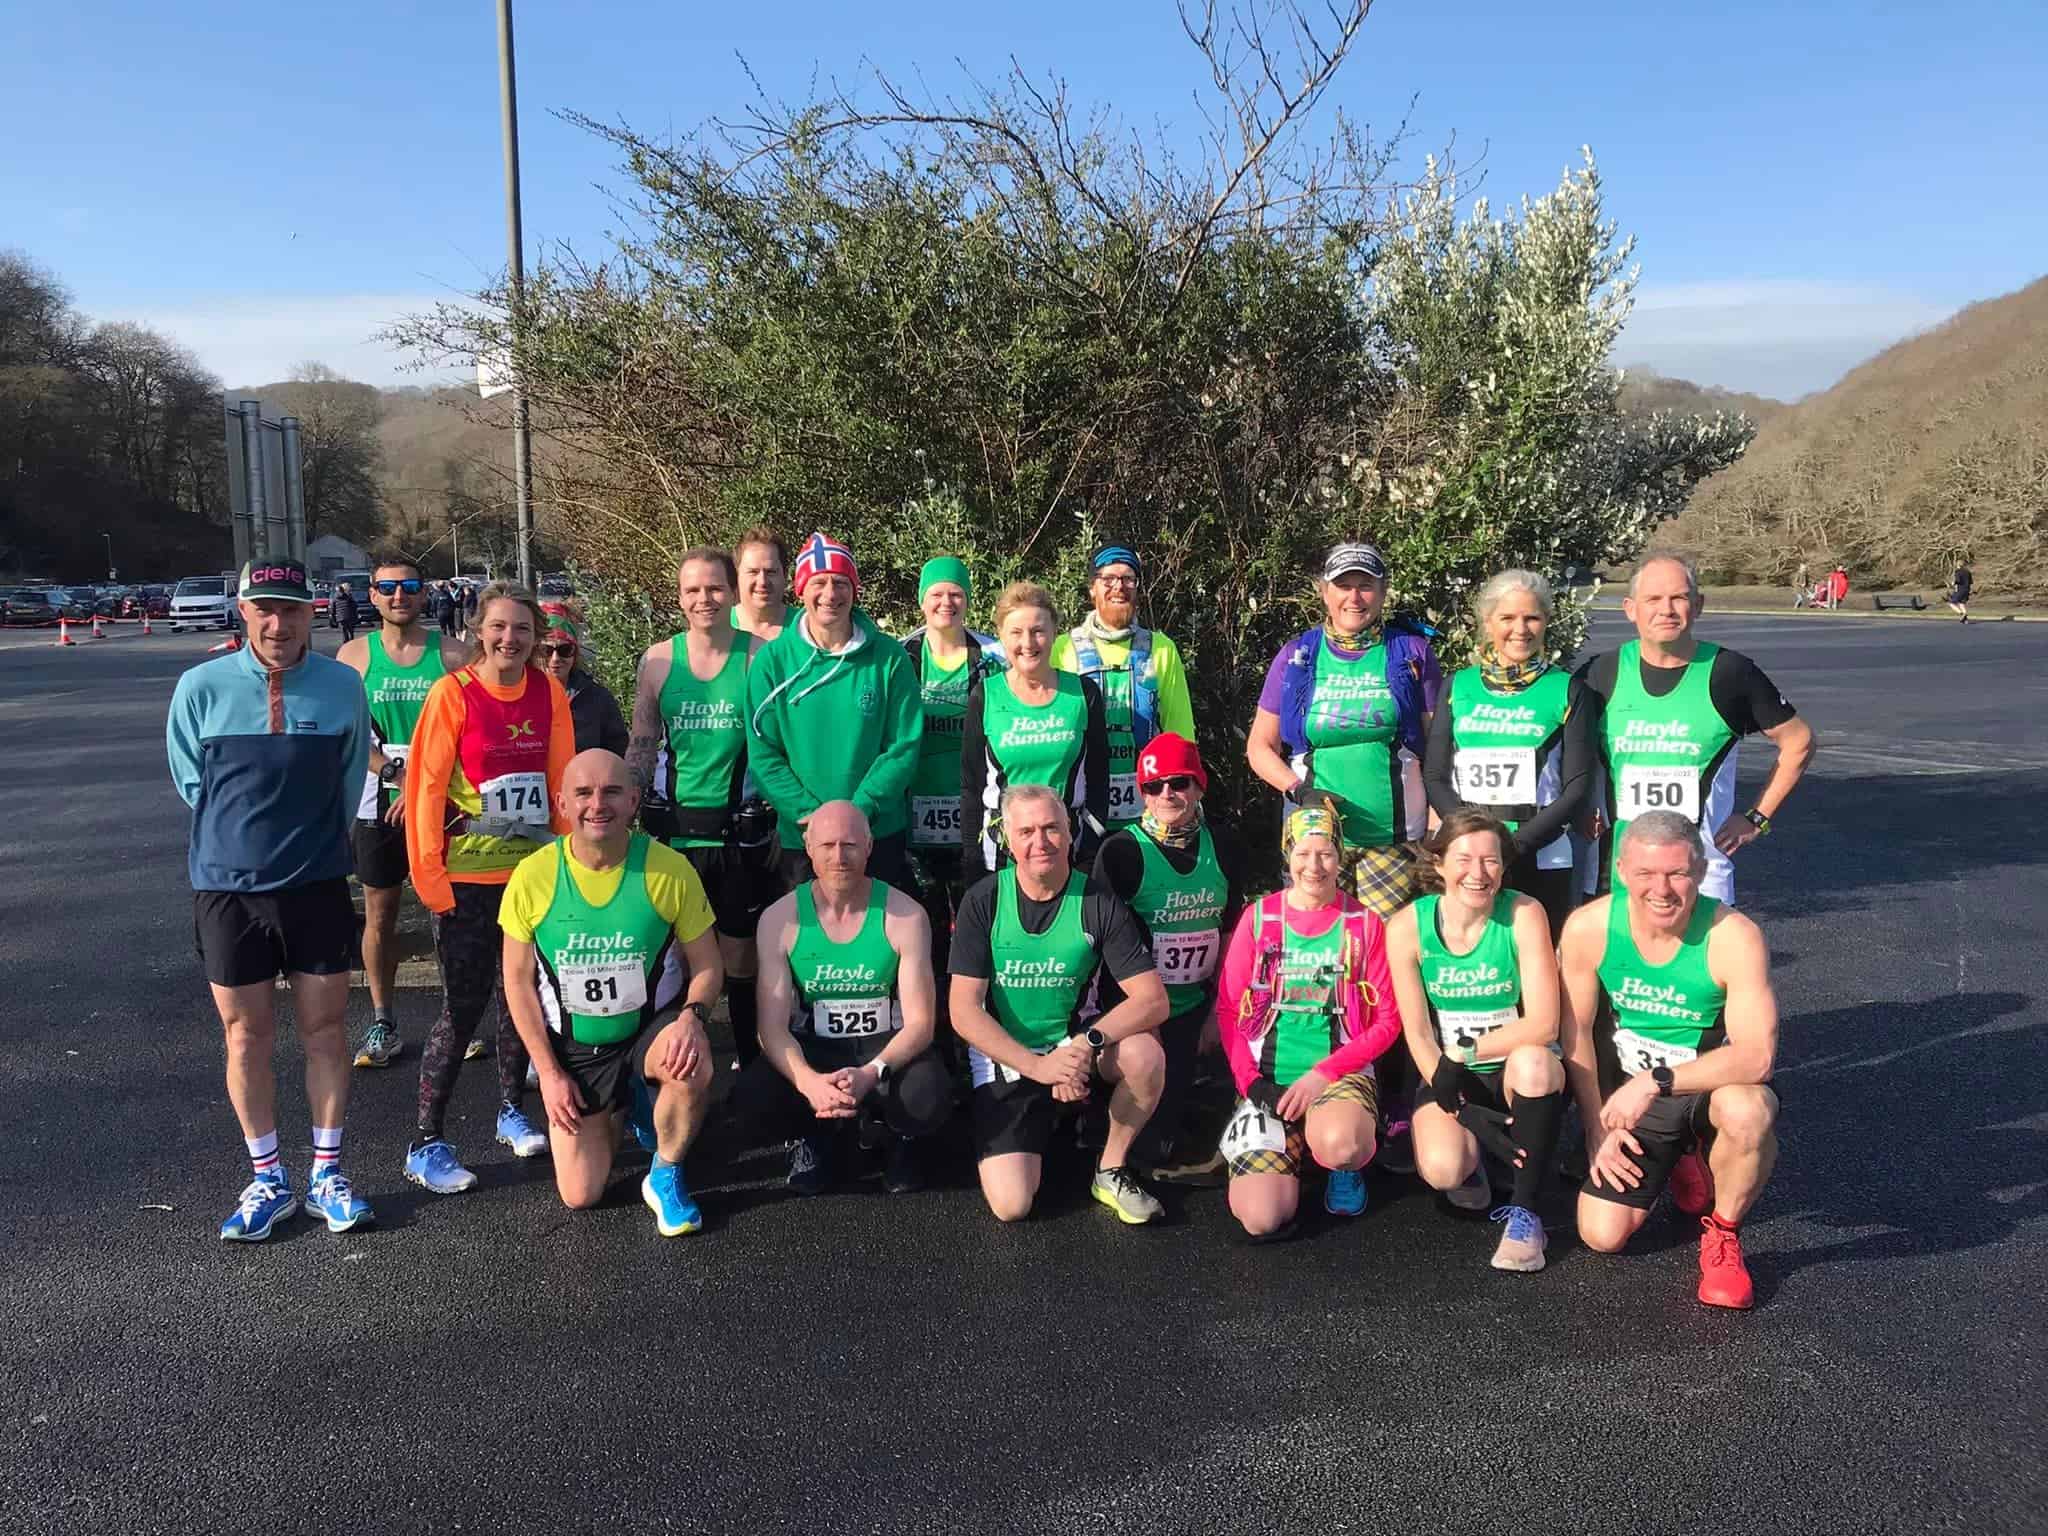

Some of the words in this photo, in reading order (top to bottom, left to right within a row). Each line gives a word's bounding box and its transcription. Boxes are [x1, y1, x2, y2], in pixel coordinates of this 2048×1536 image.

[251, 567, 305, 584] ciele
[382, 677, 432, 692] Hayle
[1327, 672, 1380, 690] Hayle
[373, 689, 427, 704] Runne
[1314, 687, 1392, 700] Runners
[680, 699, 735, 718] Hayle
[1470, 704, 1537, 721] Hayle
[672, 716, 744, 730] Runners
[1012, 714, 1065, 733] Hayle
[1459, 715, 1546, 737] Runners
[1625, 719, 1690, 740] Hayle
[999, 730, 1076, 749] Runners
[1614, 735, 1702, 756] Runners
[1142, 754, 1158, 777] R
[1469, 763, 1520, 788] 357
[495, 786, 543, 812] 174
[1630, 782, 1684, 807] 150
[1164, 888, 1215, 909] Hayle
[1152, 906, 1224, 924] Runners
[566, 931, 634, 953] Hayle
[554, 949, 647, 966] Runners
[1003, 957, 1066, 976] Hayle
[1164, 945, 1209, 970] 377
[815, 963, 876, 982] Hayle
[995, 971, 1077, 988] Runners
[1437, 961, 1499, 985] Hayle
[584, 977, 618, 1002] 81
[804, 980, 888, 993] Runners
[1428, 980, 1513, 998] Runners
[1621, 977, 1687, 1005] Hayle
[1611, 991, 1702, 1022] Runners
[828, 1011, 878, 1034] 525
[1227, 1111, 1267, 1142] 471
